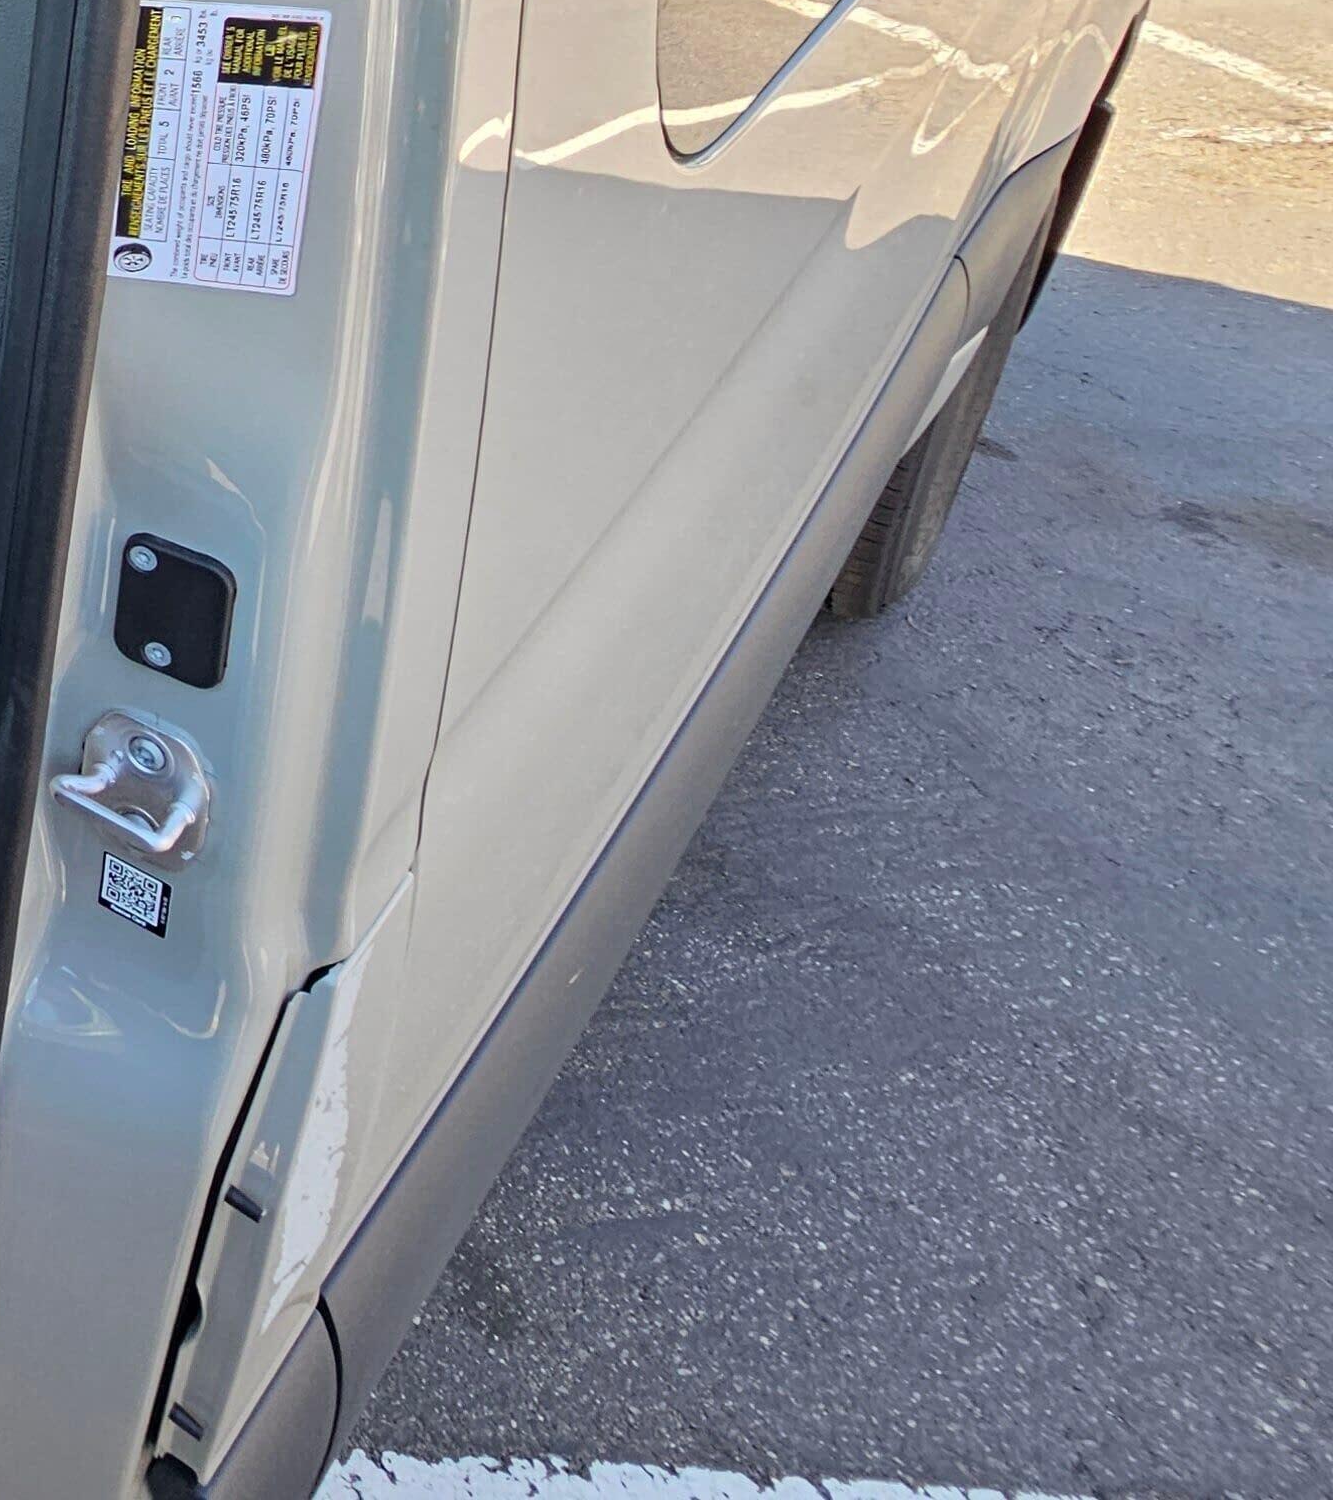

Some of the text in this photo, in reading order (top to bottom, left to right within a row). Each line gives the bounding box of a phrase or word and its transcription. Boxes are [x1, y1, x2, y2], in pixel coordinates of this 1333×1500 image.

[144, 9, 162, 68] CHARGEMENT
[196, 22, 208, 47] 3453
[144, 71, 155, 81] LE
[164, 68, 175, 76] 2
[143, 84, 154, 94] ET
[121, 48, 147, 196] TIRE AND LOADING INFORMATION
[139, 97, 153, 125] PNEUS
[158, 133, 168, 155] TOTAL
